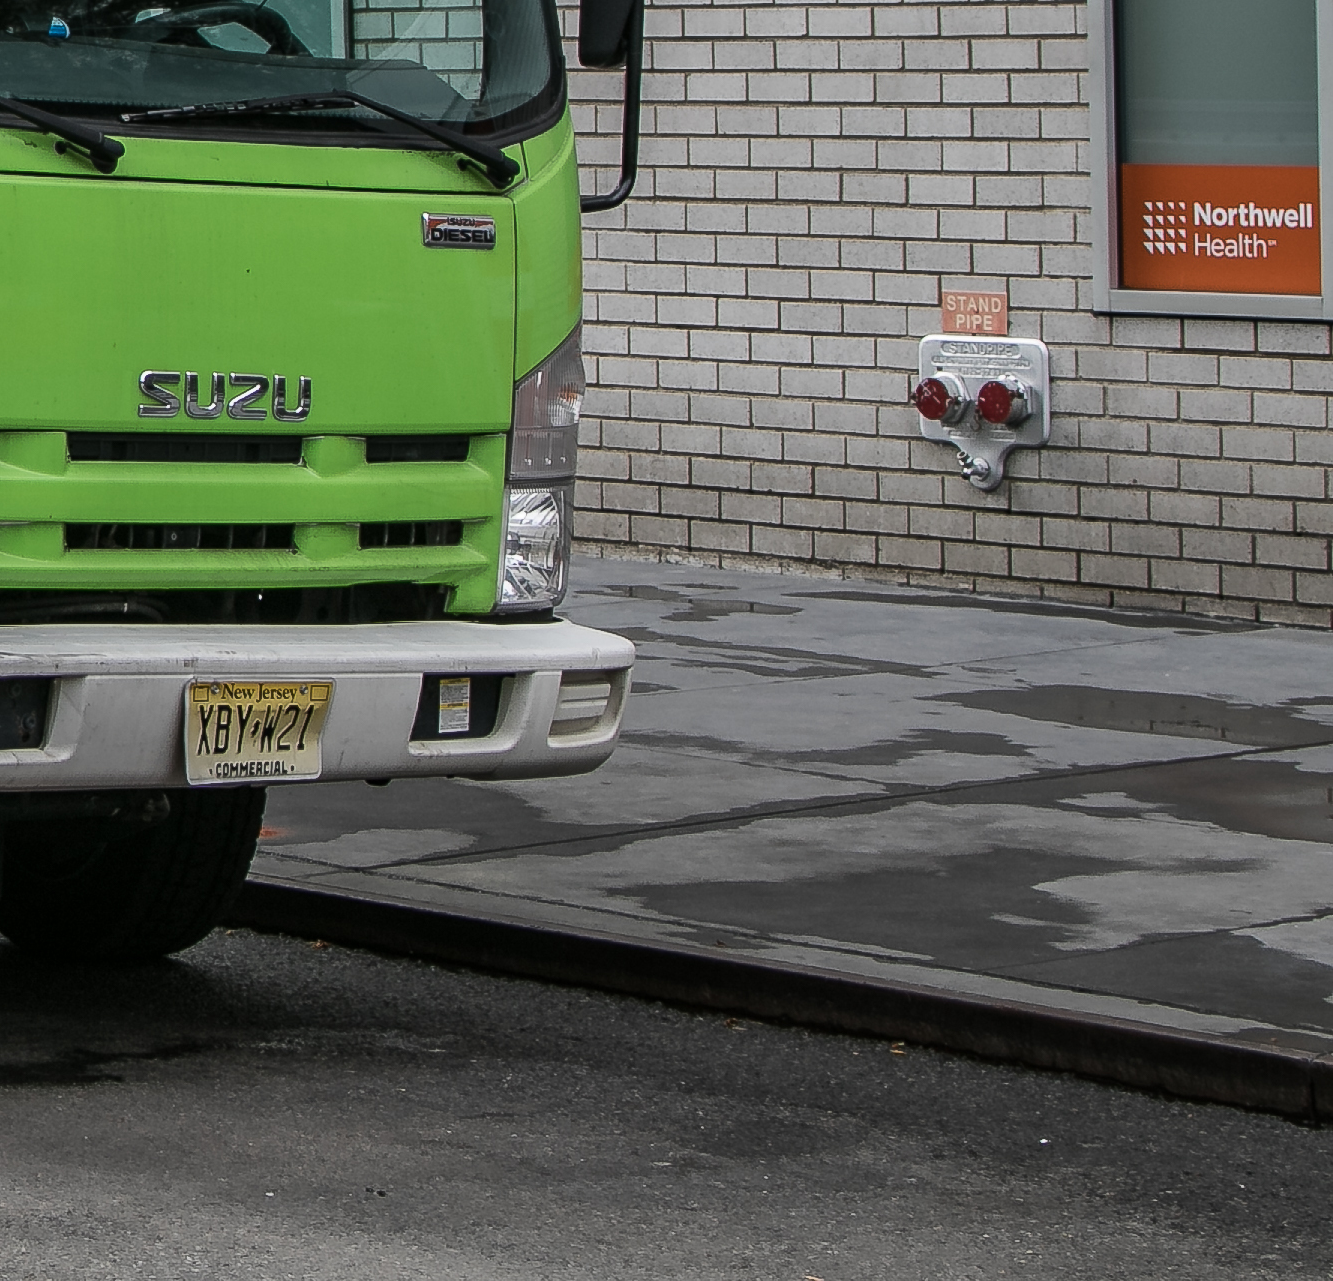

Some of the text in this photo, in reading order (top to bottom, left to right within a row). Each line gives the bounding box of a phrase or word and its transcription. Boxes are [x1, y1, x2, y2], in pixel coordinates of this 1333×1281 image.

[1193, 201, 1313, 228] Northwell
[431, 228, 495, 243] DIESEL
[946, 295, 1002, 313] STAND
[956, 314, 993, 331] PIPE
[138, 368, 312, 422] SUZU
[221, 682, 298, 703] New Jersey
[215, 760, 289, 779] COMMERCIAL
